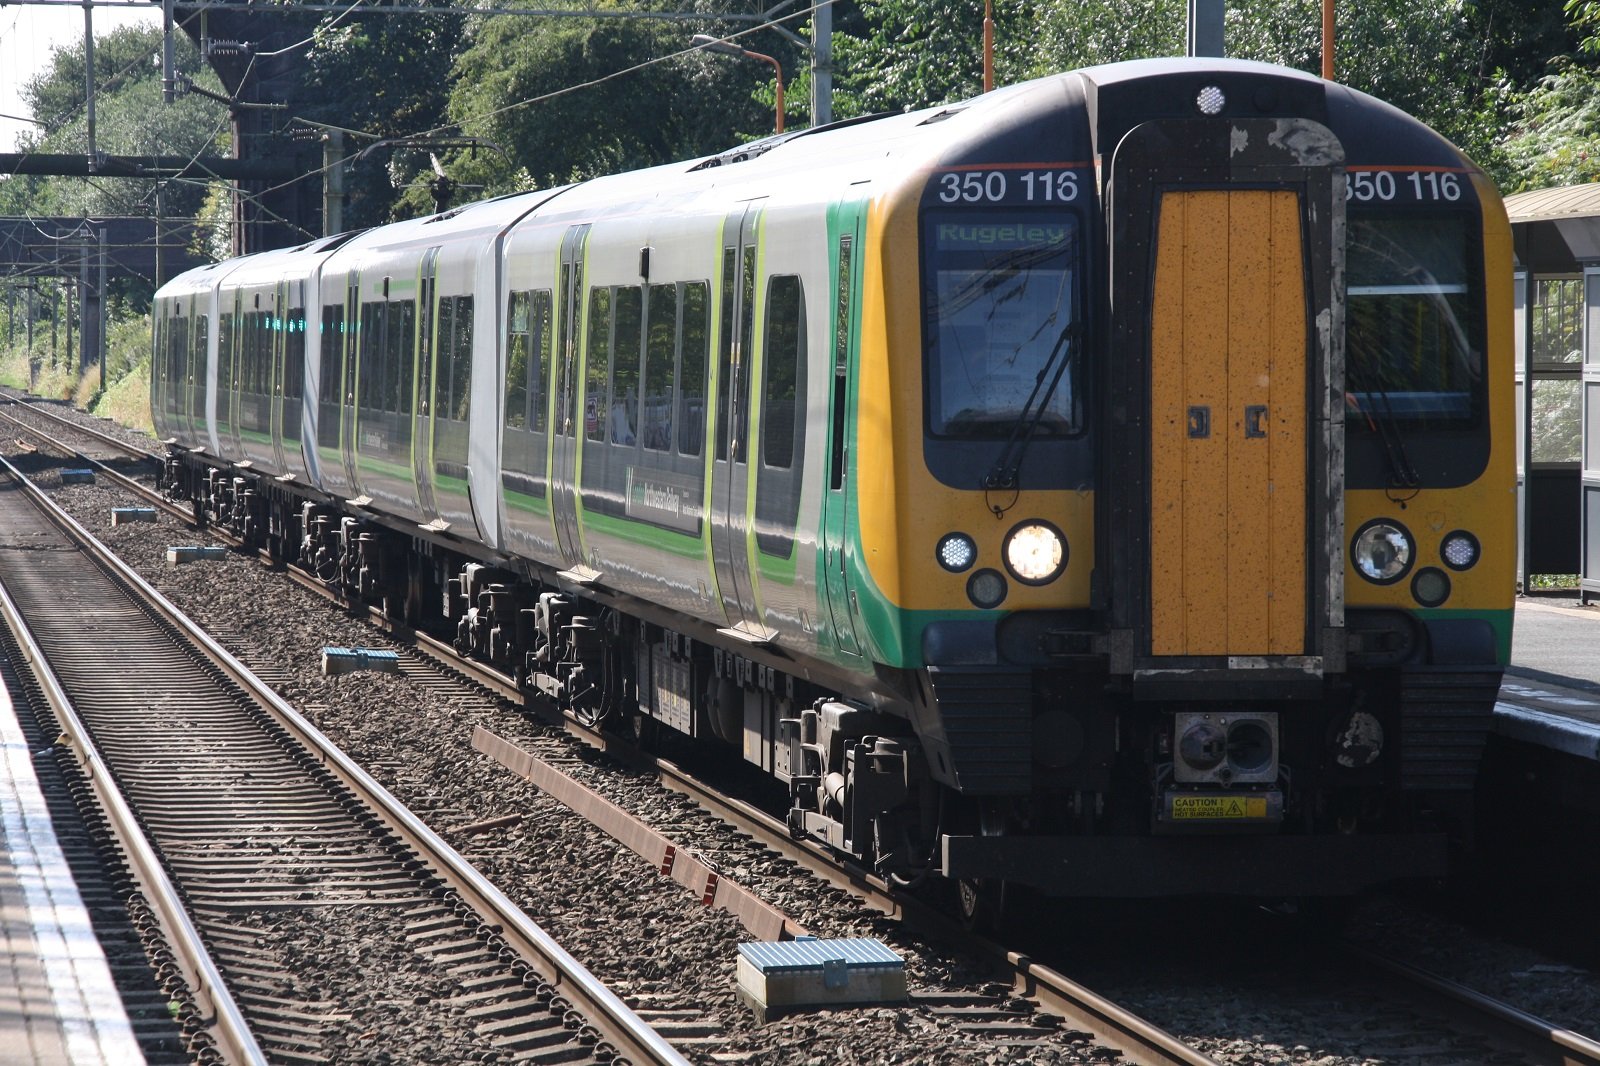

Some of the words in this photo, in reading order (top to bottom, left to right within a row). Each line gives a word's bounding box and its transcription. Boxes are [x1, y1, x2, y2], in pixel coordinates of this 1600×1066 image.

[939, 171, 1007, 202] 350
[1020, 171, 1078, 201] 116
[1407, 171, 1461, 201] 116
[939, 224, 1065, 244] Rugeley
[1175, 799, 1217, 807] CAUTION
